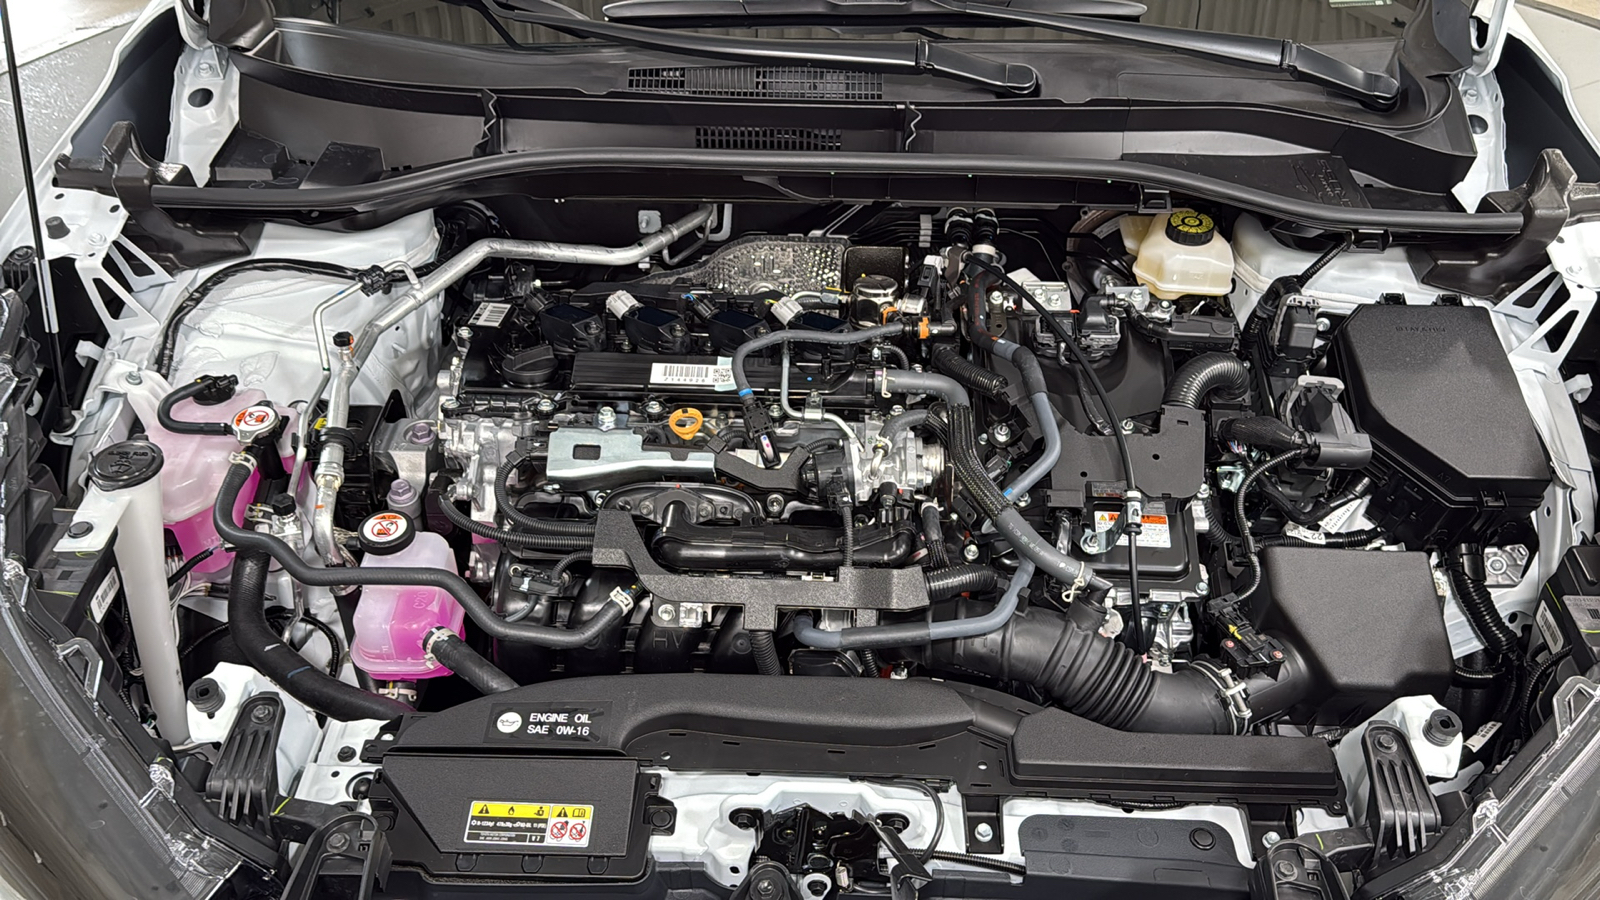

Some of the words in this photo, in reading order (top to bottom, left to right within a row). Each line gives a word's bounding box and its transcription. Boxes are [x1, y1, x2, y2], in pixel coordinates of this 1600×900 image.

[652, 630, 685, 649] HV
[529, 712, 569, 723] ENGINE
[574, 713, 592, 724] OIL
[527, 724, 550, 735] SAE
[556, 725, 590, 736] 0W-16
